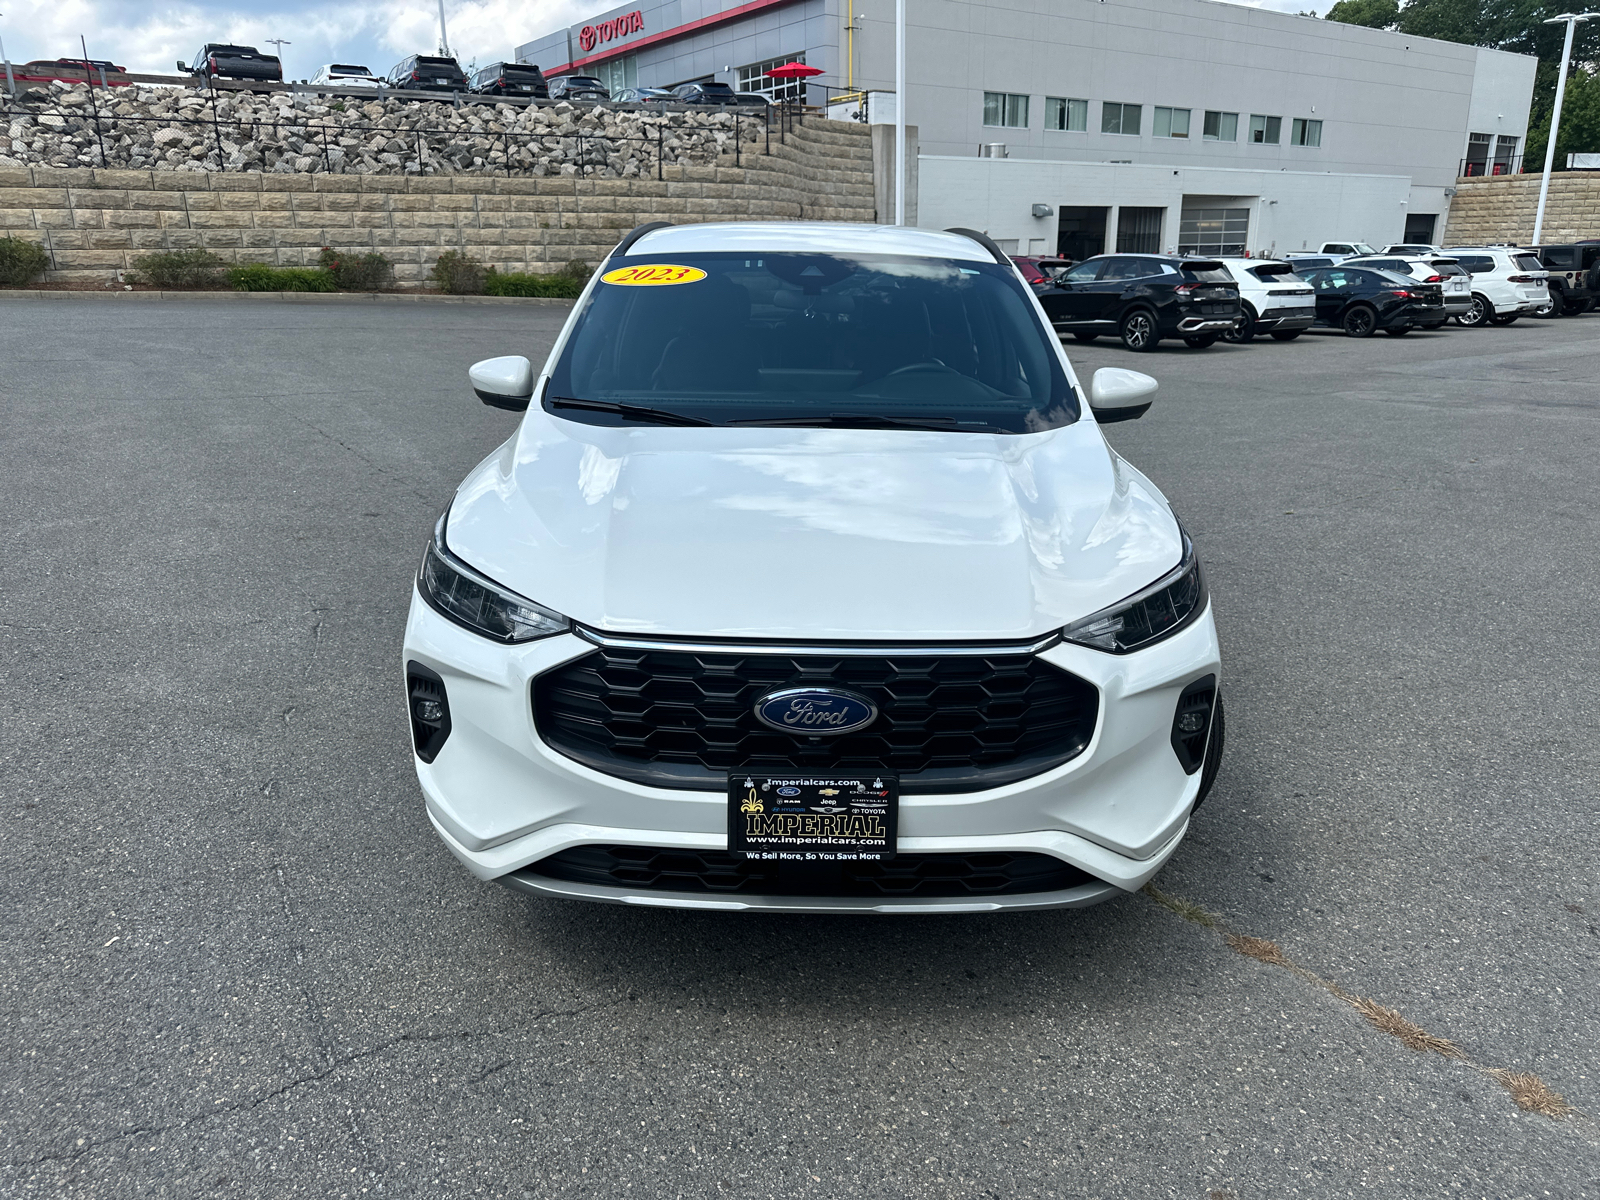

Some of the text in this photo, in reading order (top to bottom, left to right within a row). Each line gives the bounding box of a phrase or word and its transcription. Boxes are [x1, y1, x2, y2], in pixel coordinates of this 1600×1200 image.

[596, 10, 644, 43] TOYOTA
[615, 268, 691, 282] 2023
[783, 698, 849, 725] Ford
[767, 778, 861, 787] Imperialcars.com
[820, 798, 837, 806] Jeep
[746, 813, 886, 838] IMPERIAL
[746, 835, 886, 846] www.imperialcars.com
[779, 852, 804, 861] More,
[805, 852, 817, 860] So
[818, 852, 835, 860] You
